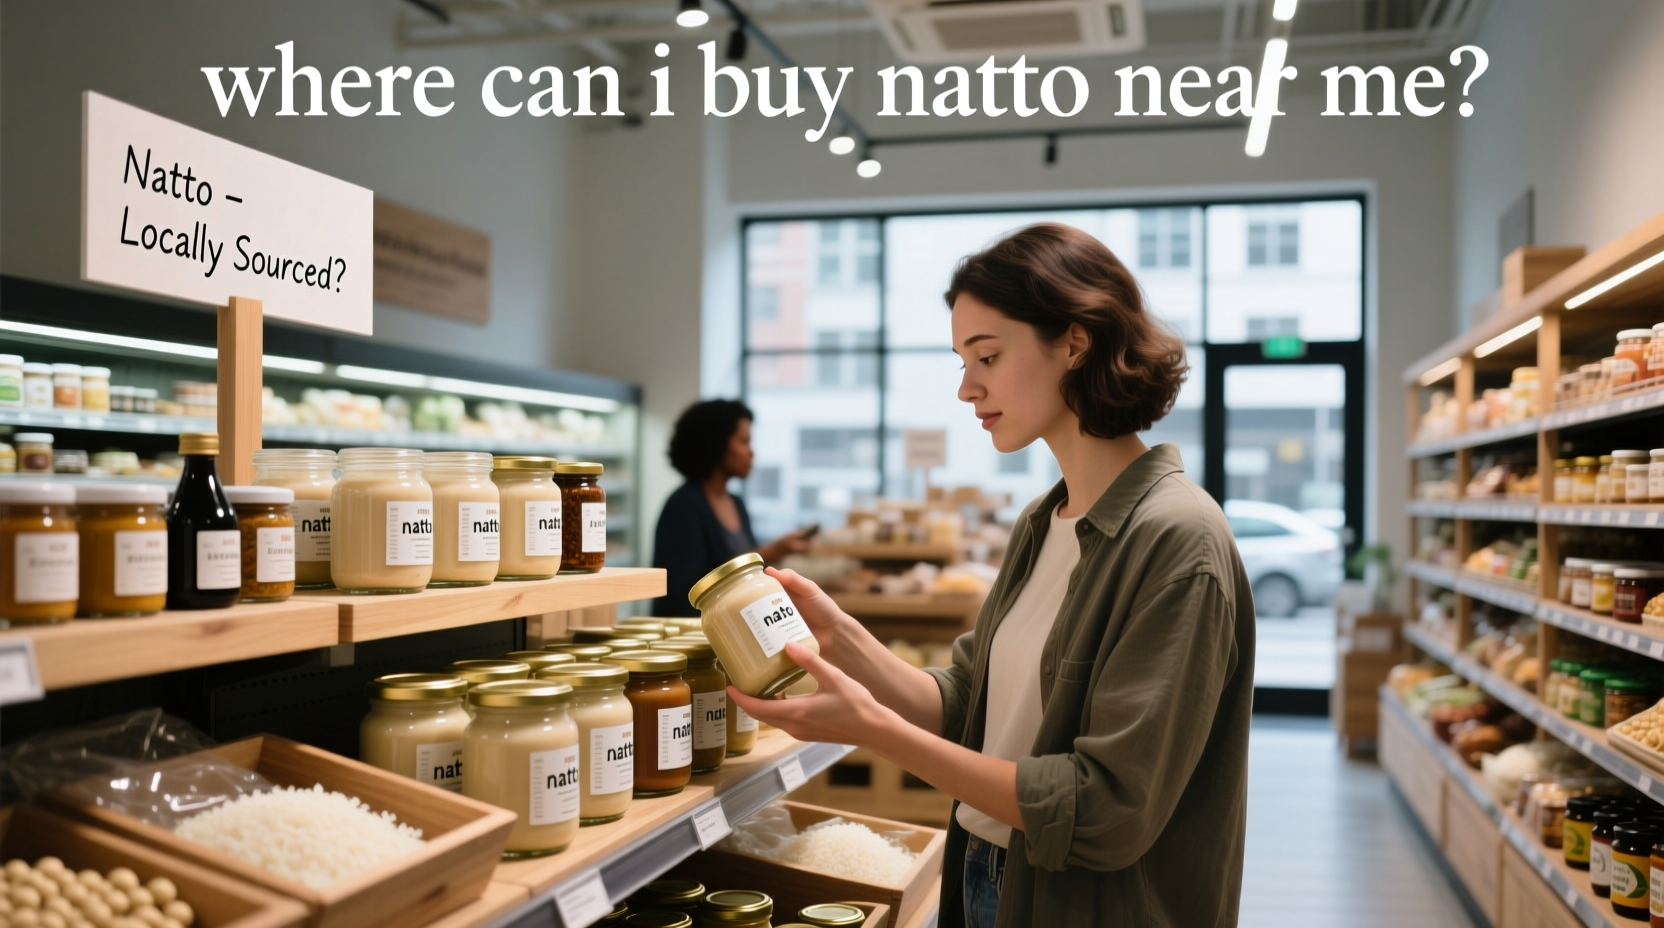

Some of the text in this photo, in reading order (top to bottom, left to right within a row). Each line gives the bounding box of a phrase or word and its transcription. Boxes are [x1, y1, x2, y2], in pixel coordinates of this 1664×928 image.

[123, 144, 213, 207] Natto
[120, 205, 224, 278] Locally
[233, 234, 347, 293] Sourced?
[607, 740, 633, 762] natt
